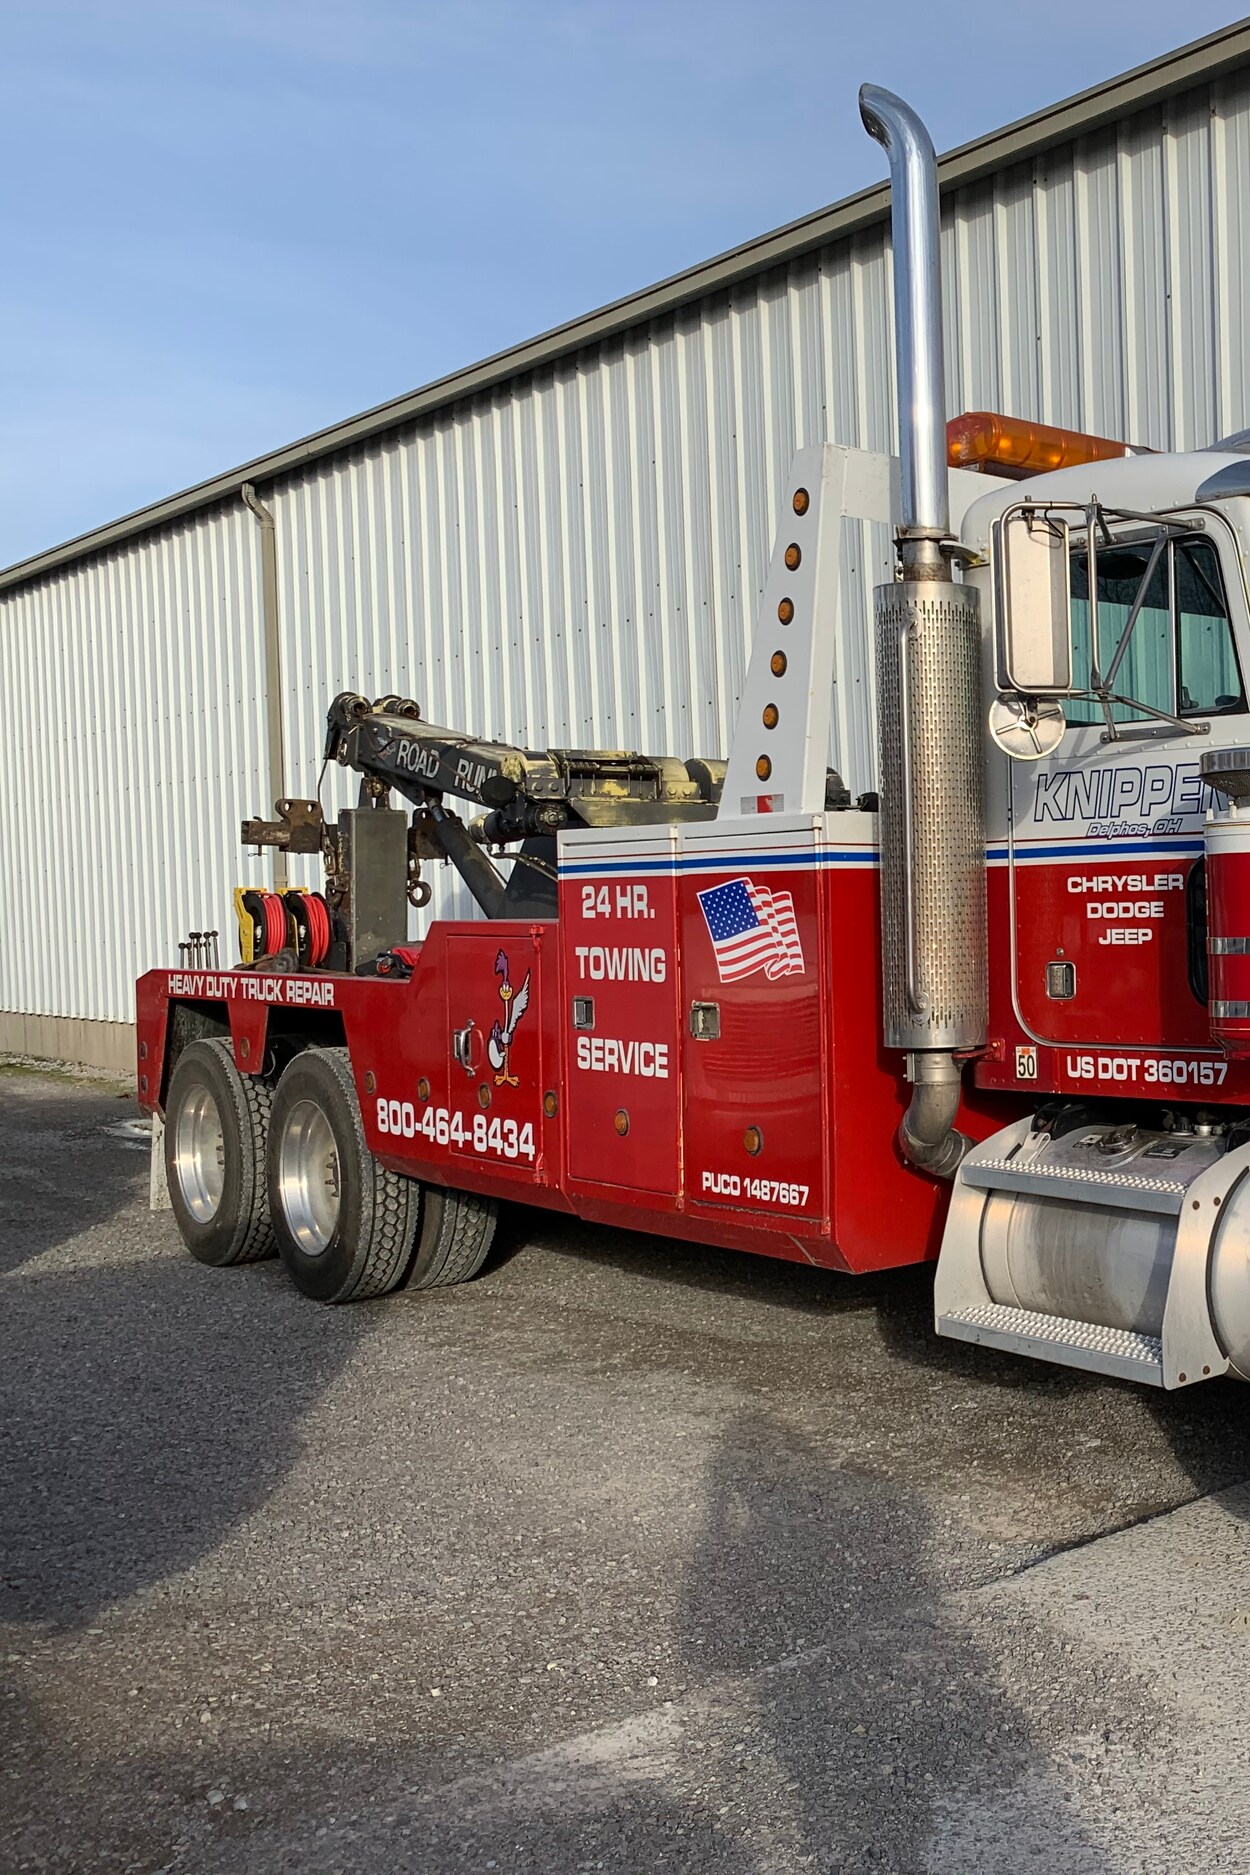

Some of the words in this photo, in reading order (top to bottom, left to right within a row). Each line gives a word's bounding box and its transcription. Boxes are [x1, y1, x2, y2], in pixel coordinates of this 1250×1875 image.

[396, 739, 440, 778] ROAD
[1086, 821, 1151, 840] Delphos,
[1152, 818, 1183, 834] OH
[1067, 874, 1184, 893] CHRYSLER
[582, 885, 612, 919] 24
[616, 885, 656, 919] HR.
[1086, 901, 1165, 919] DODGE
[1098, 928, 1153, 945] JEEP
[575, 946, 666, 983] TOWING
[168, 973, 205, 996] HEAVY
[205, 976, 238, 999] DUTY
[240, 977, 284, 1002] TRUCK
[286, 980, 335, 1006] REPAIR
[577, 1036, 669, 1079] SERVICE
[1018, 1054, 1036, 1077] 50
[1067, 1055, 1095, 1079] US
[1098, 1057, 1141, 1081] DOT
[1143, 1059, 1229, 1086] 360157
[376, 1097, 536, 1162] 800-464-8434
[702, 1171, 741, 1196] PUCO
[743, 1177, 810, 1207] 1487667
